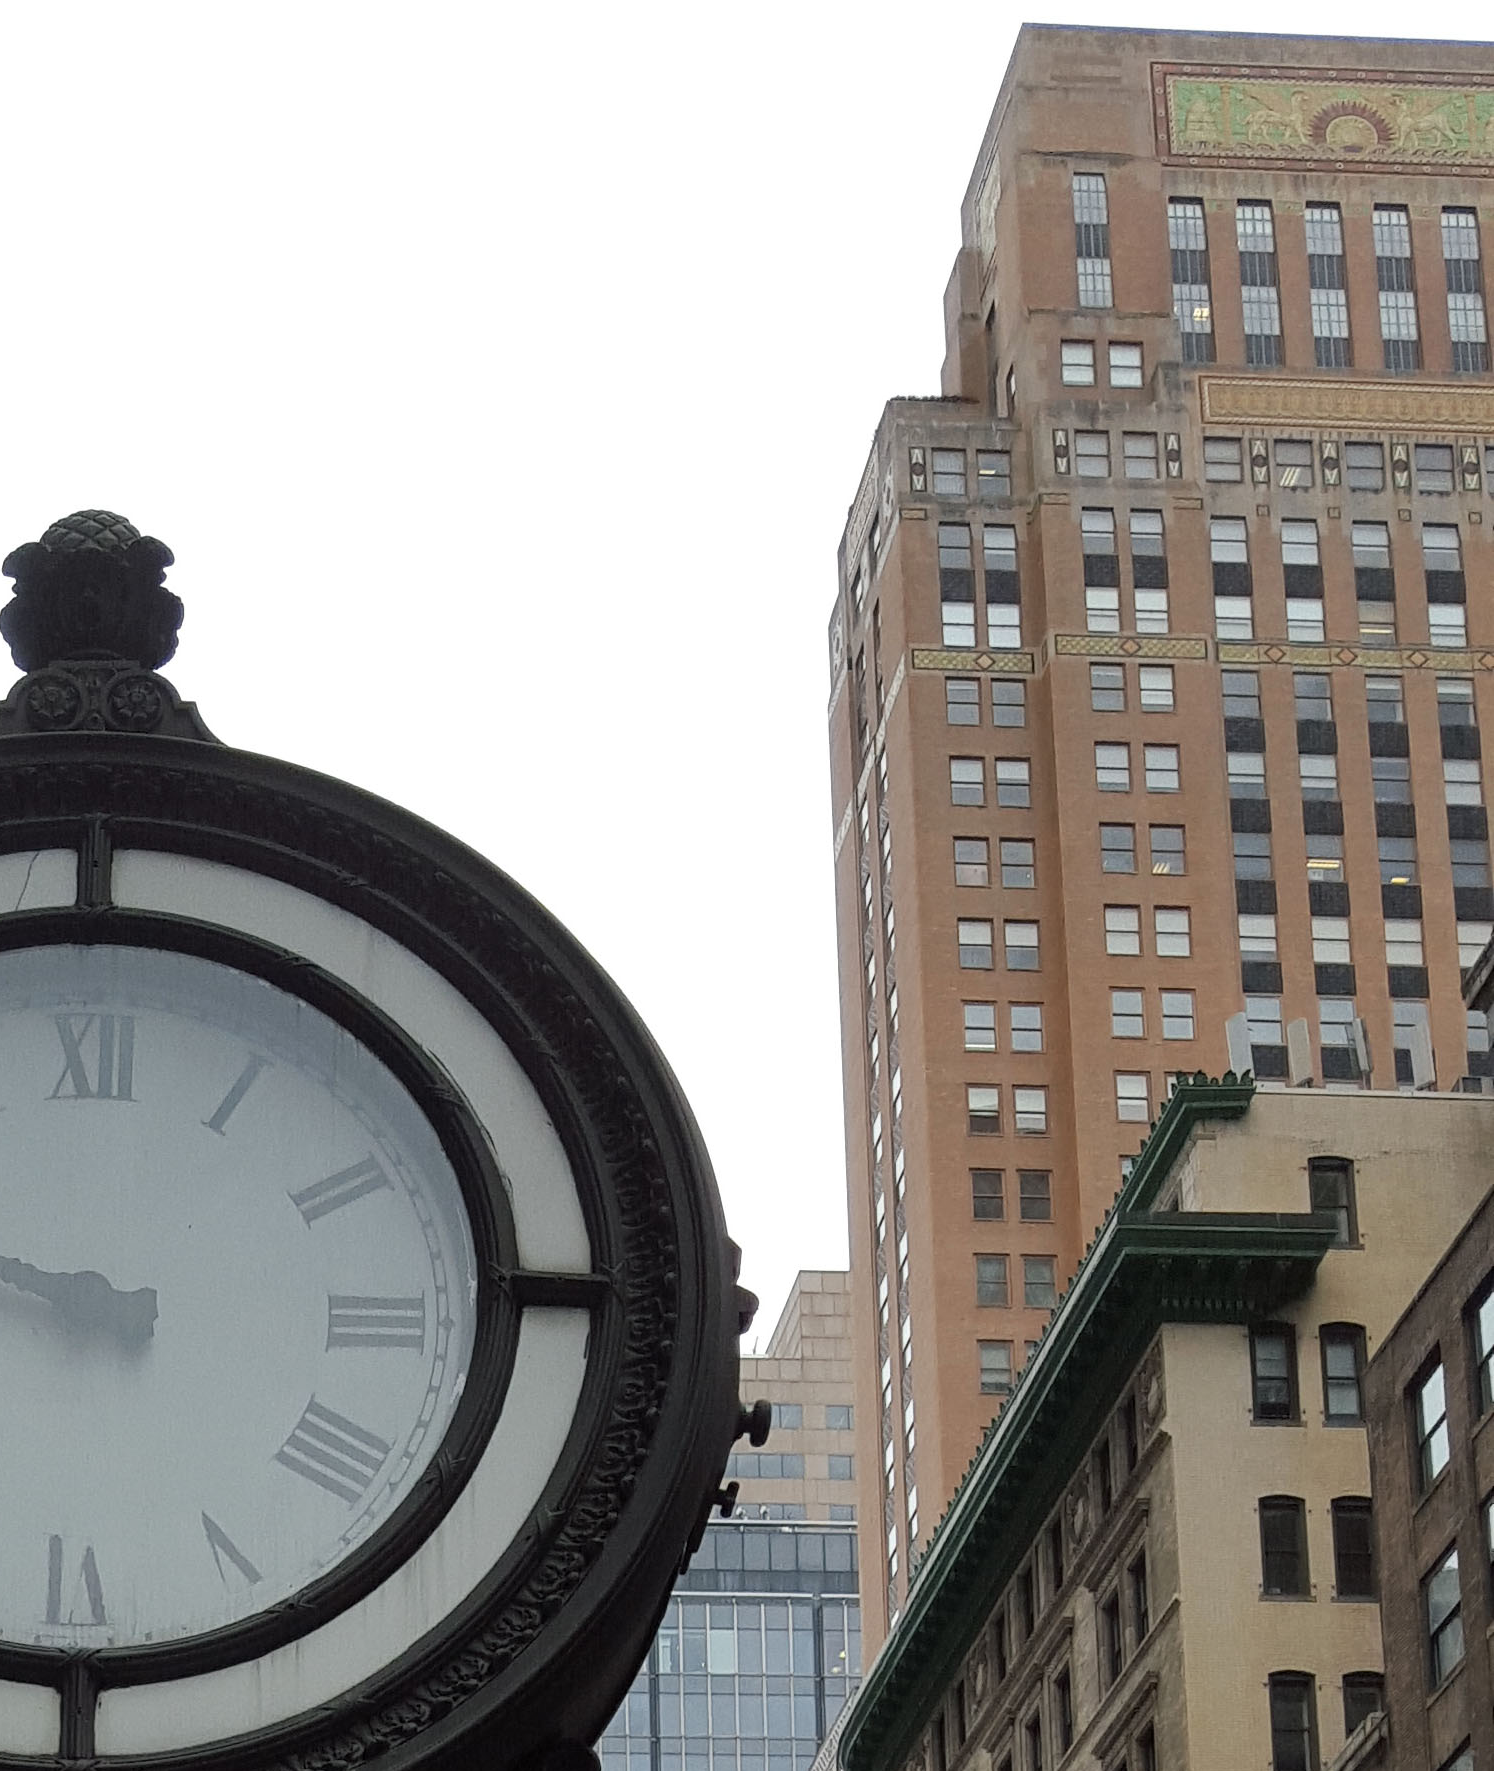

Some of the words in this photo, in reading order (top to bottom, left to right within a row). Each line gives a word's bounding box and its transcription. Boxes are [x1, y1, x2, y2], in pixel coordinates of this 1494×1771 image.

[44, 1013, 138, 1101] XII
[201, 1053, 274, 1136] I
[286, 1155, 394, 1230] II
[326, 1290, 425, 1355] III
[202, 1510, 263, 1585] V
